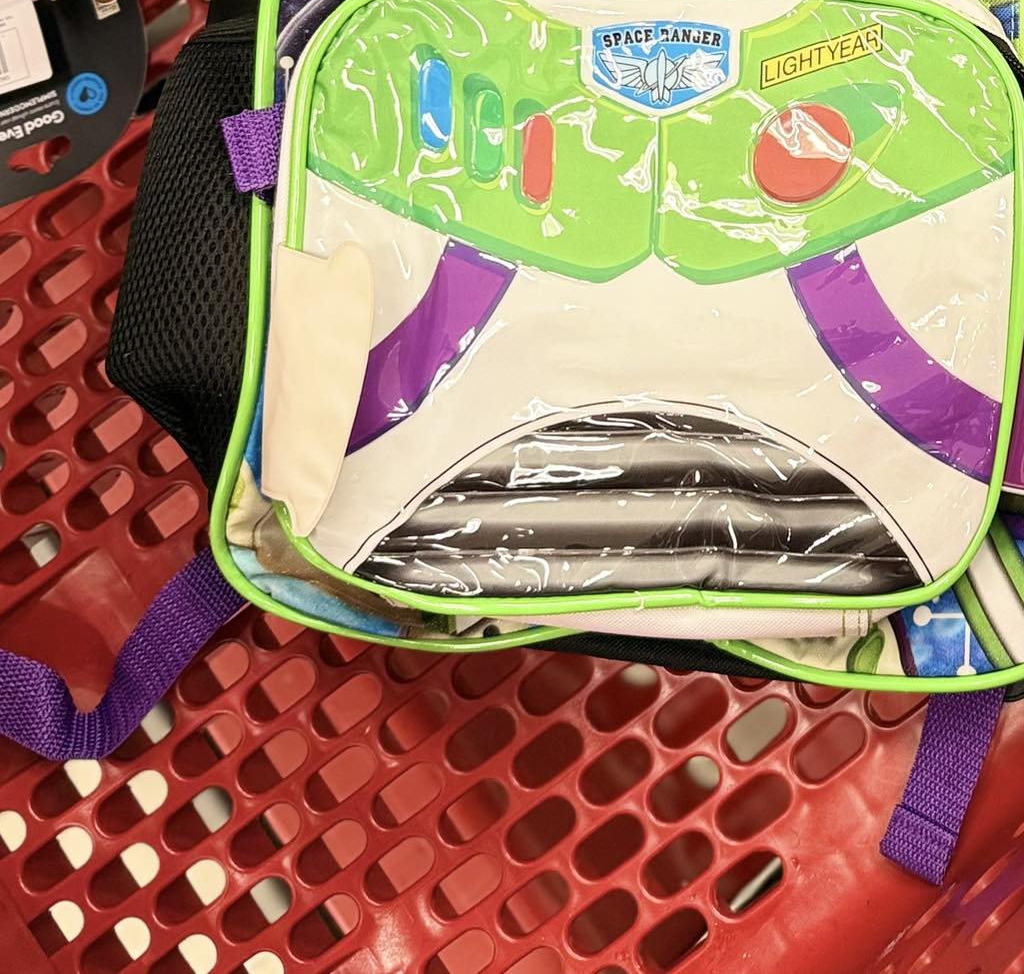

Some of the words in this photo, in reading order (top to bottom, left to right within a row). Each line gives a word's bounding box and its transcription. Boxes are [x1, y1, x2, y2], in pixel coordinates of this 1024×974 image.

[602, 29, 653, 48] SPACE
[660, 28, 722, 48] RANGER
[764, 29, 880, 83] LIGHTYEAR
[25, 110, 66, 135] Good
